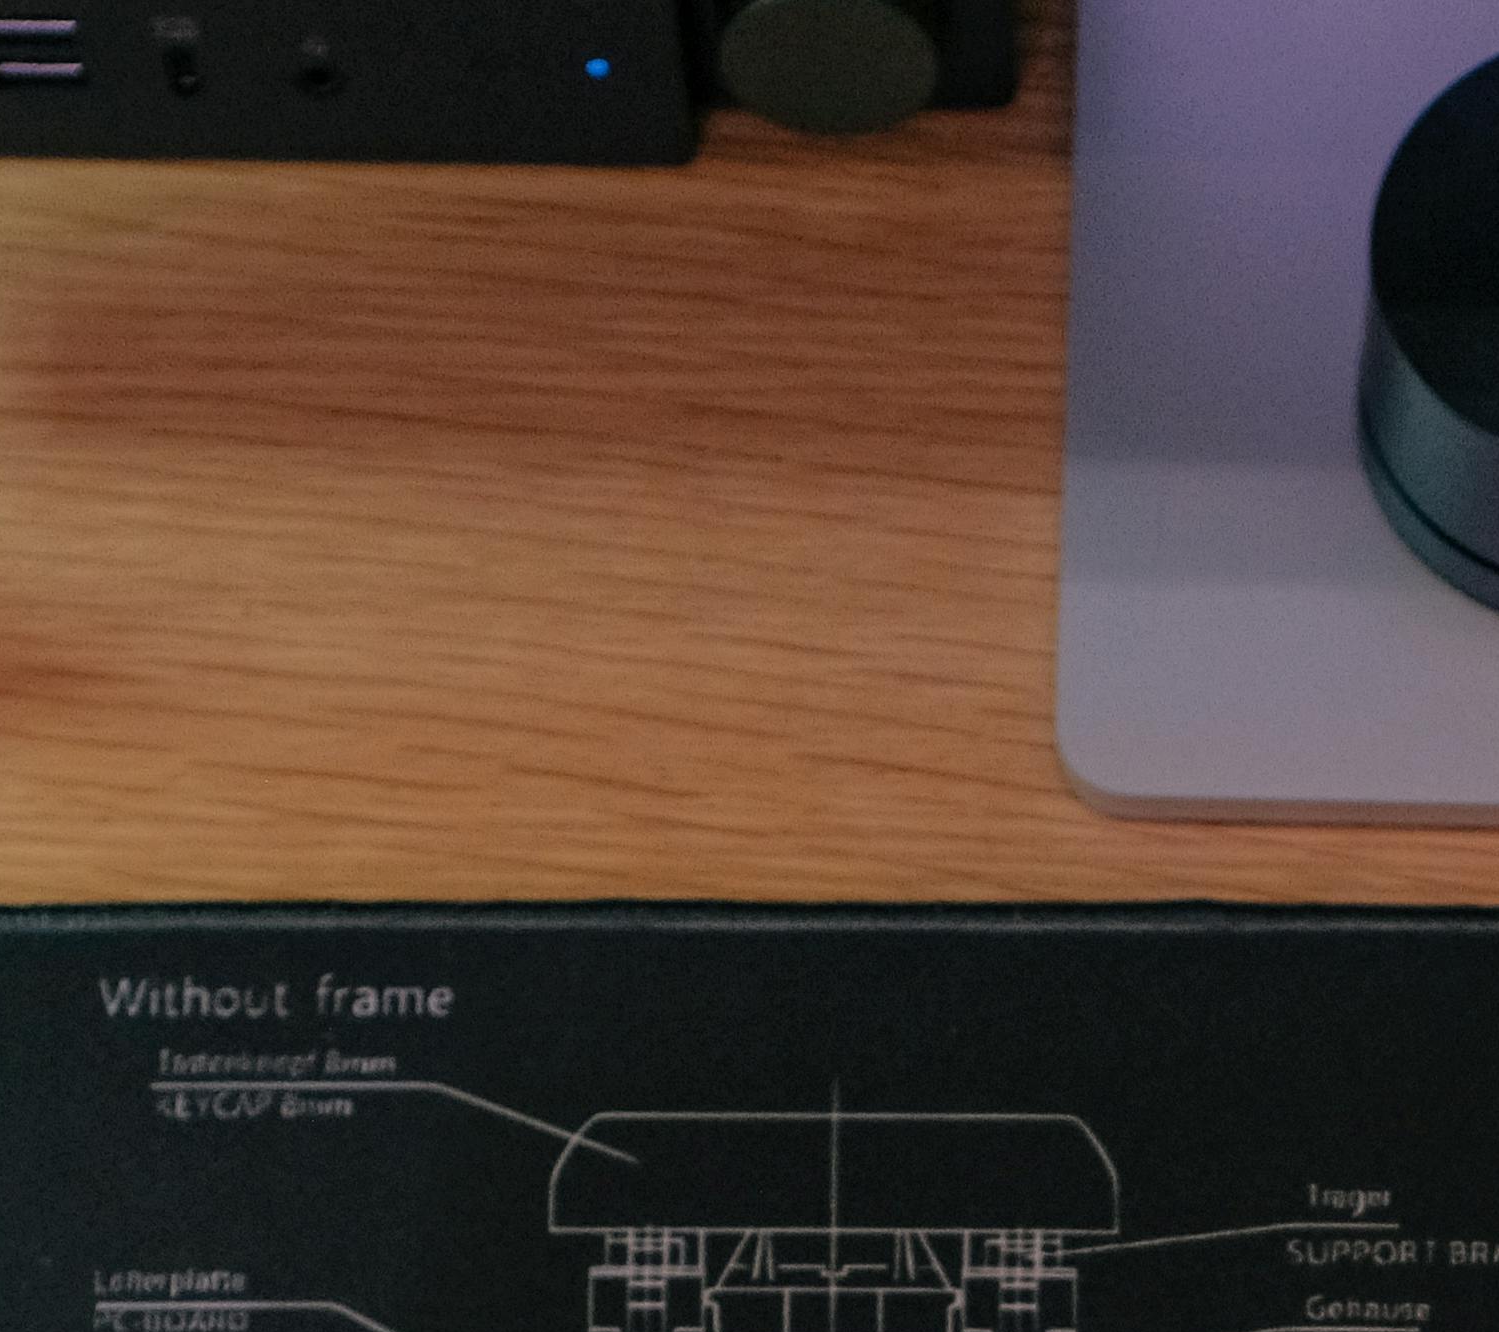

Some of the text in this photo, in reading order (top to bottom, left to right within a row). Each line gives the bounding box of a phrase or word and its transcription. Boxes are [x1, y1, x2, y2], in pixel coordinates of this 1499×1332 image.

[101, 973, 456, 1018] Without frame
[1286, 1241, 1435, 1267] SUPPORT
